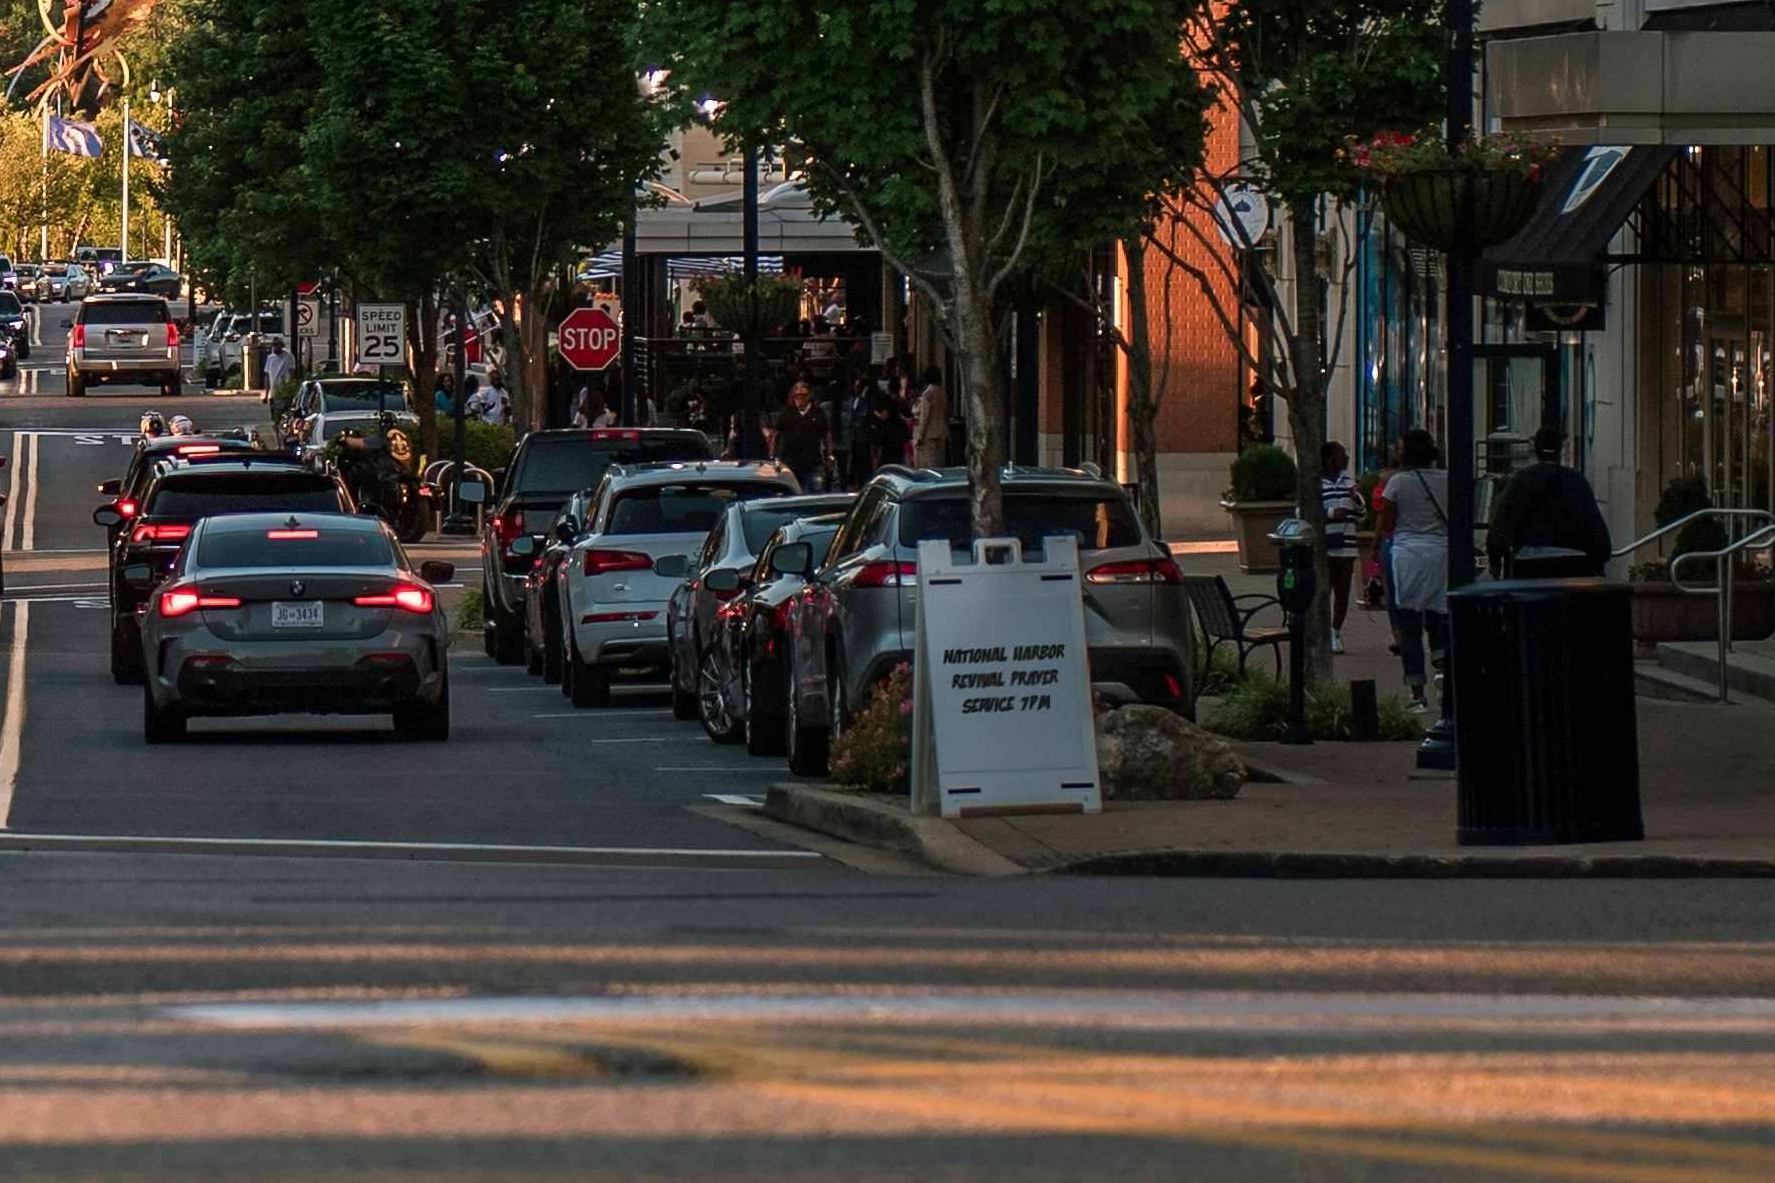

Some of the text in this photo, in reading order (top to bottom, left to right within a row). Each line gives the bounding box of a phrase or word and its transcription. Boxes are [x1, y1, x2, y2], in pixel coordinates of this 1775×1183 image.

[361, 310, 402, 321] SPEED
[366, 324, 397, 334] LIMIT
[563, 327, 616, 350] STOP
[364, 335, 400, 358] 25
[943, 644, 1065, 665] NATIONAL HARBOR
[952, 669, 1059, 689] REVIVAL PRAYER
[962, 694, 1051, 714] SERVICE 7PM
